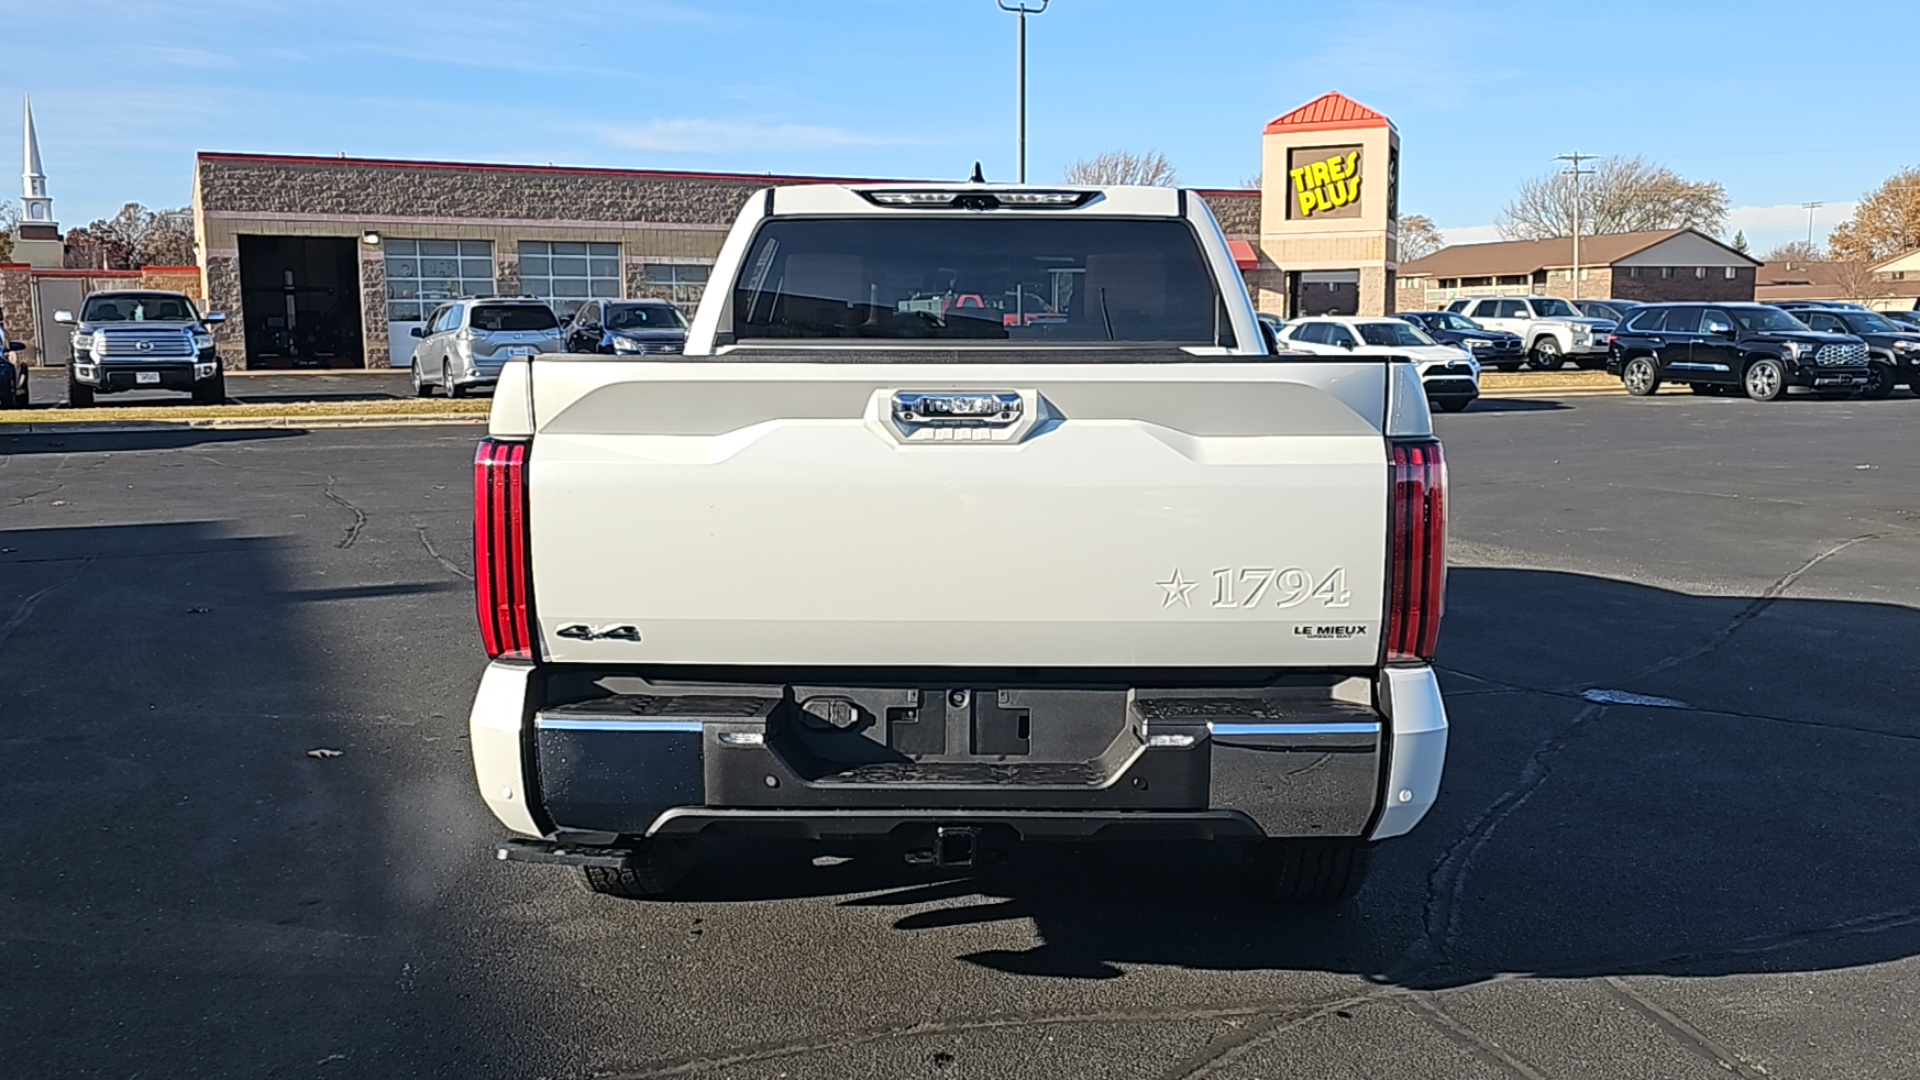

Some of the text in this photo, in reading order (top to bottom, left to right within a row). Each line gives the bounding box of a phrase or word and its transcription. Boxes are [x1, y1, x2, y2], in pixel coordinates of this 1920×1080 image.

[1290, 151, 1358, 192] TIRES
[1299, 175, 1361, 216] PLUS
[1211, 566, 1351, 609] 1794
[1294, 625, 1367, 635] LE MIEUX
